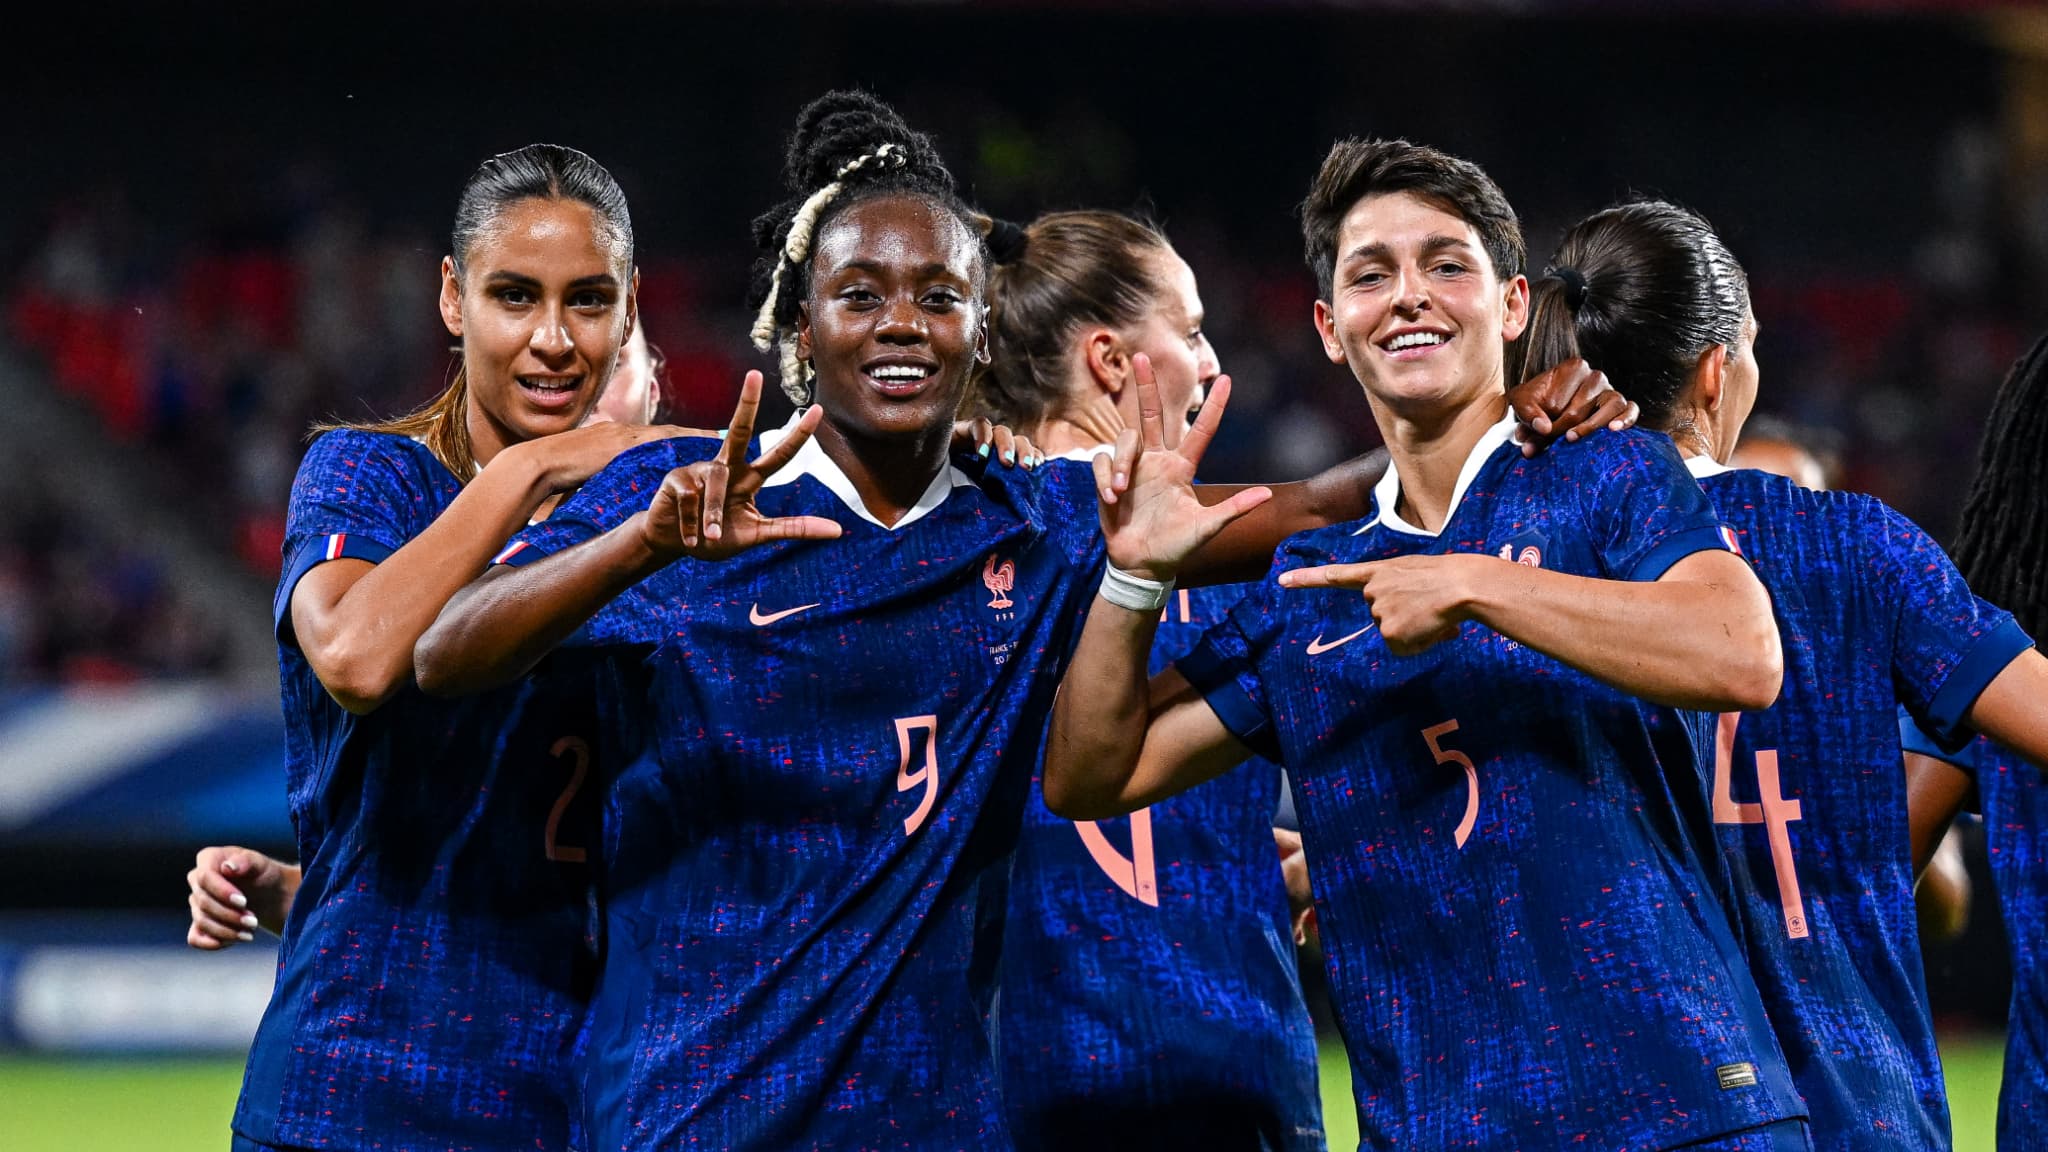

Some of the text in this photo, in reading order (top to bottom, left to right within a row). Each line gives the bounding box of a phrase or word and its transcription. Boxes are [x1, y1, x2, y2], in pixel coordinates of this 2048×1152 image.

[545, 734, 590, 863] 2
[895, 714, 939, 837] 9
[1421, 718, 1480, 850] 5
[1712, 711, 1809, 939] 4
